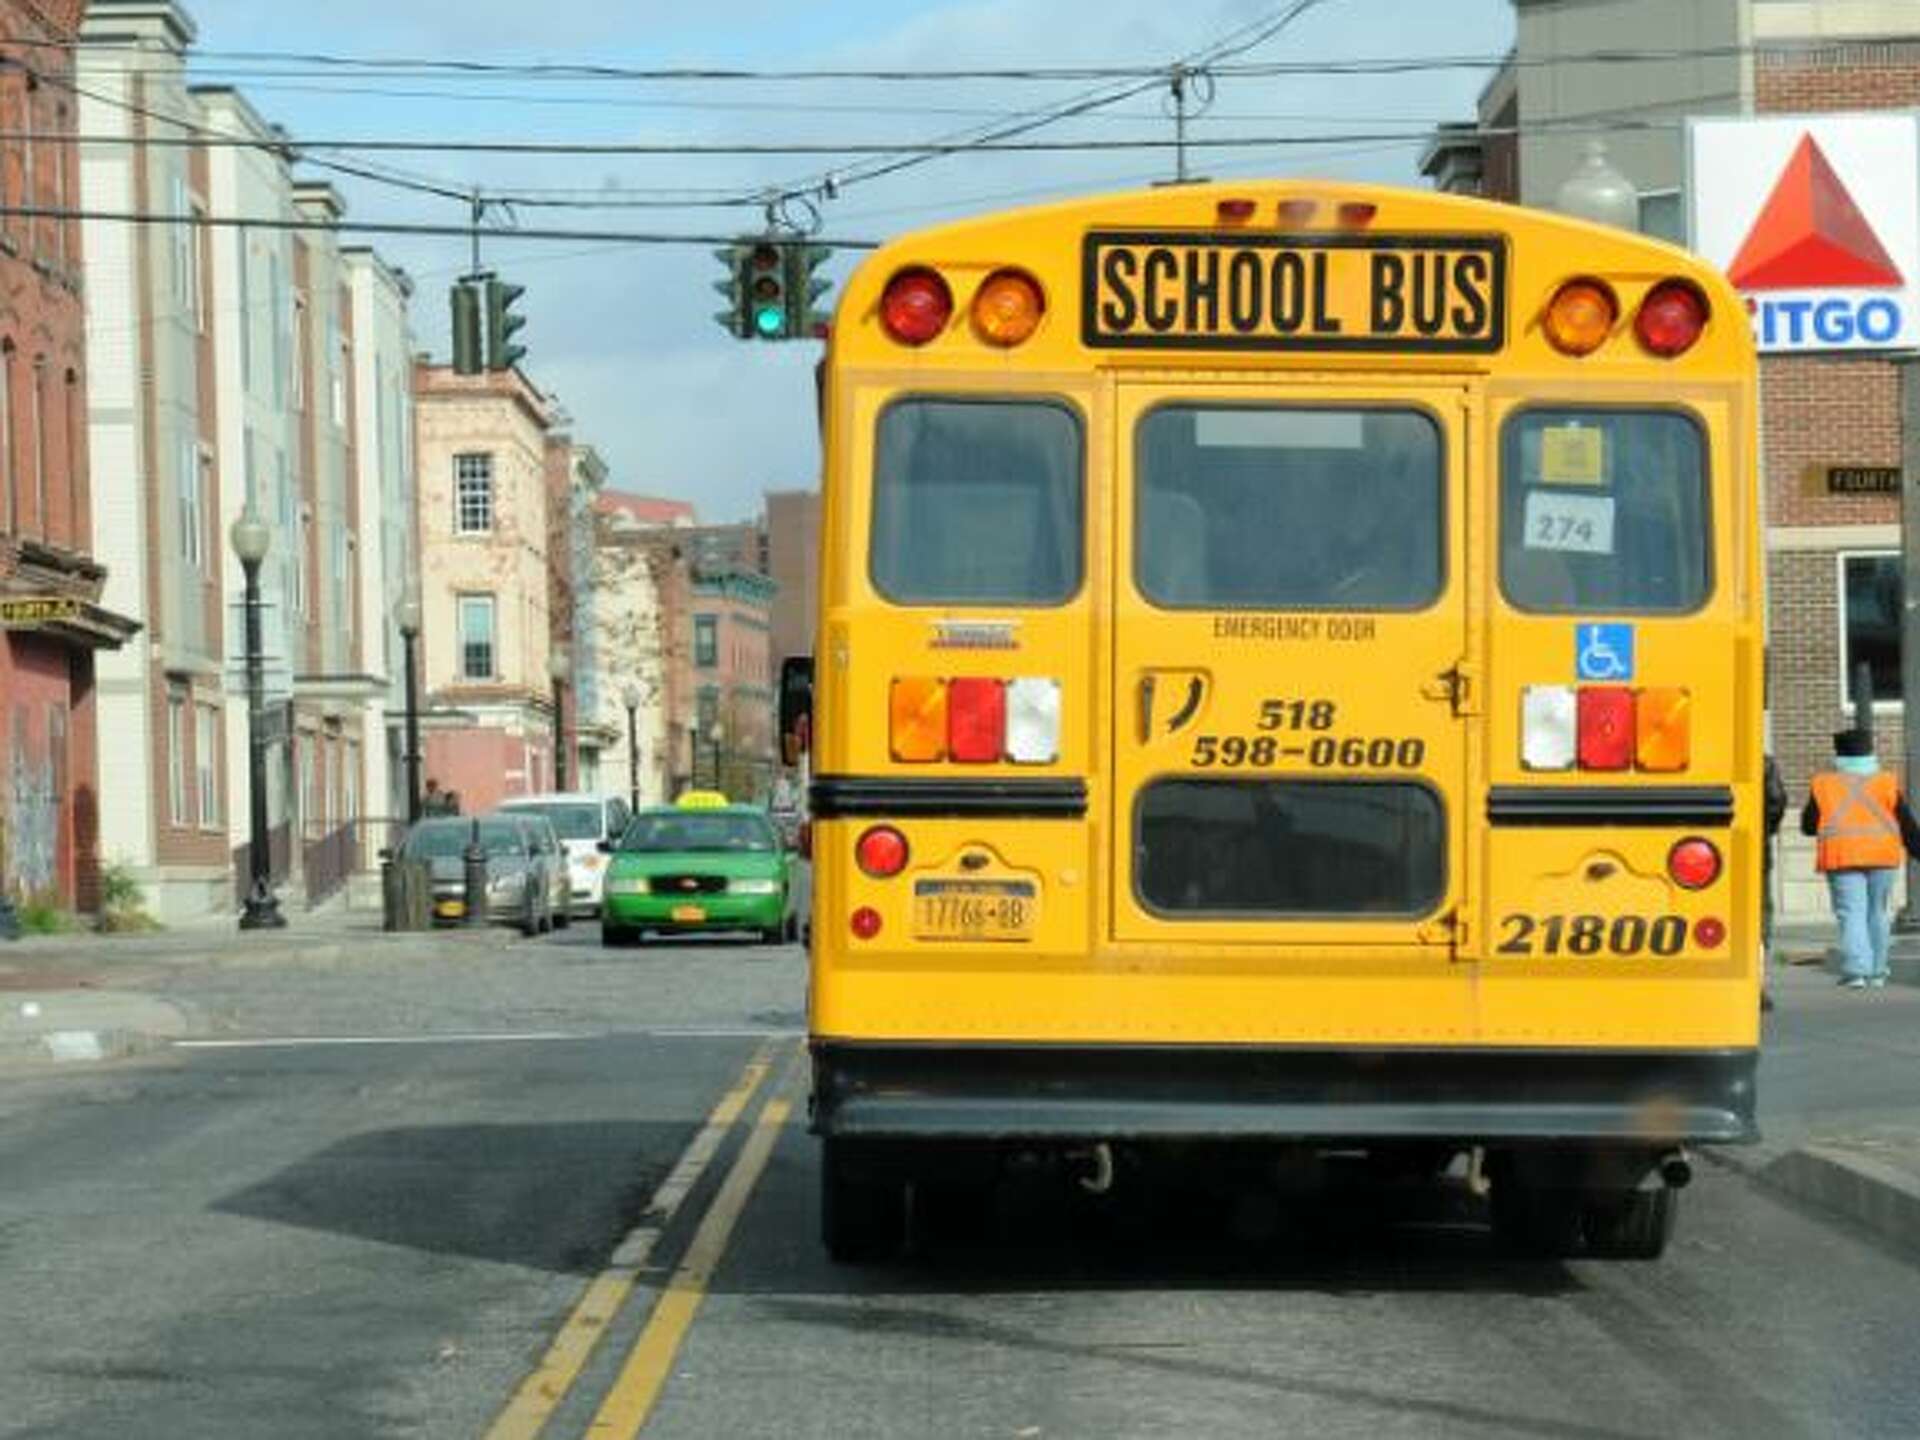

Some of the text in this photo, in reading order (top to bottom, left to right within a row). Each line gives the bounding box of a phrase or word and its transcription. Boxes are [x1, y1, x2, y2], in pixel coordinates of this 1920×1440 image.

[1102, 247, 1489, 336] SCHOOL BUS
[1749, 298, 1901, 344] ITGO
[1537, 515, 1594, 544] 274
[1213, 616, 1321, 640] EMERGENCY
[1257, 699, 1338, 731] 518
[1190, 736, 1426, 768] 598-0600
[1496, 913, 1688, 956] 21800
